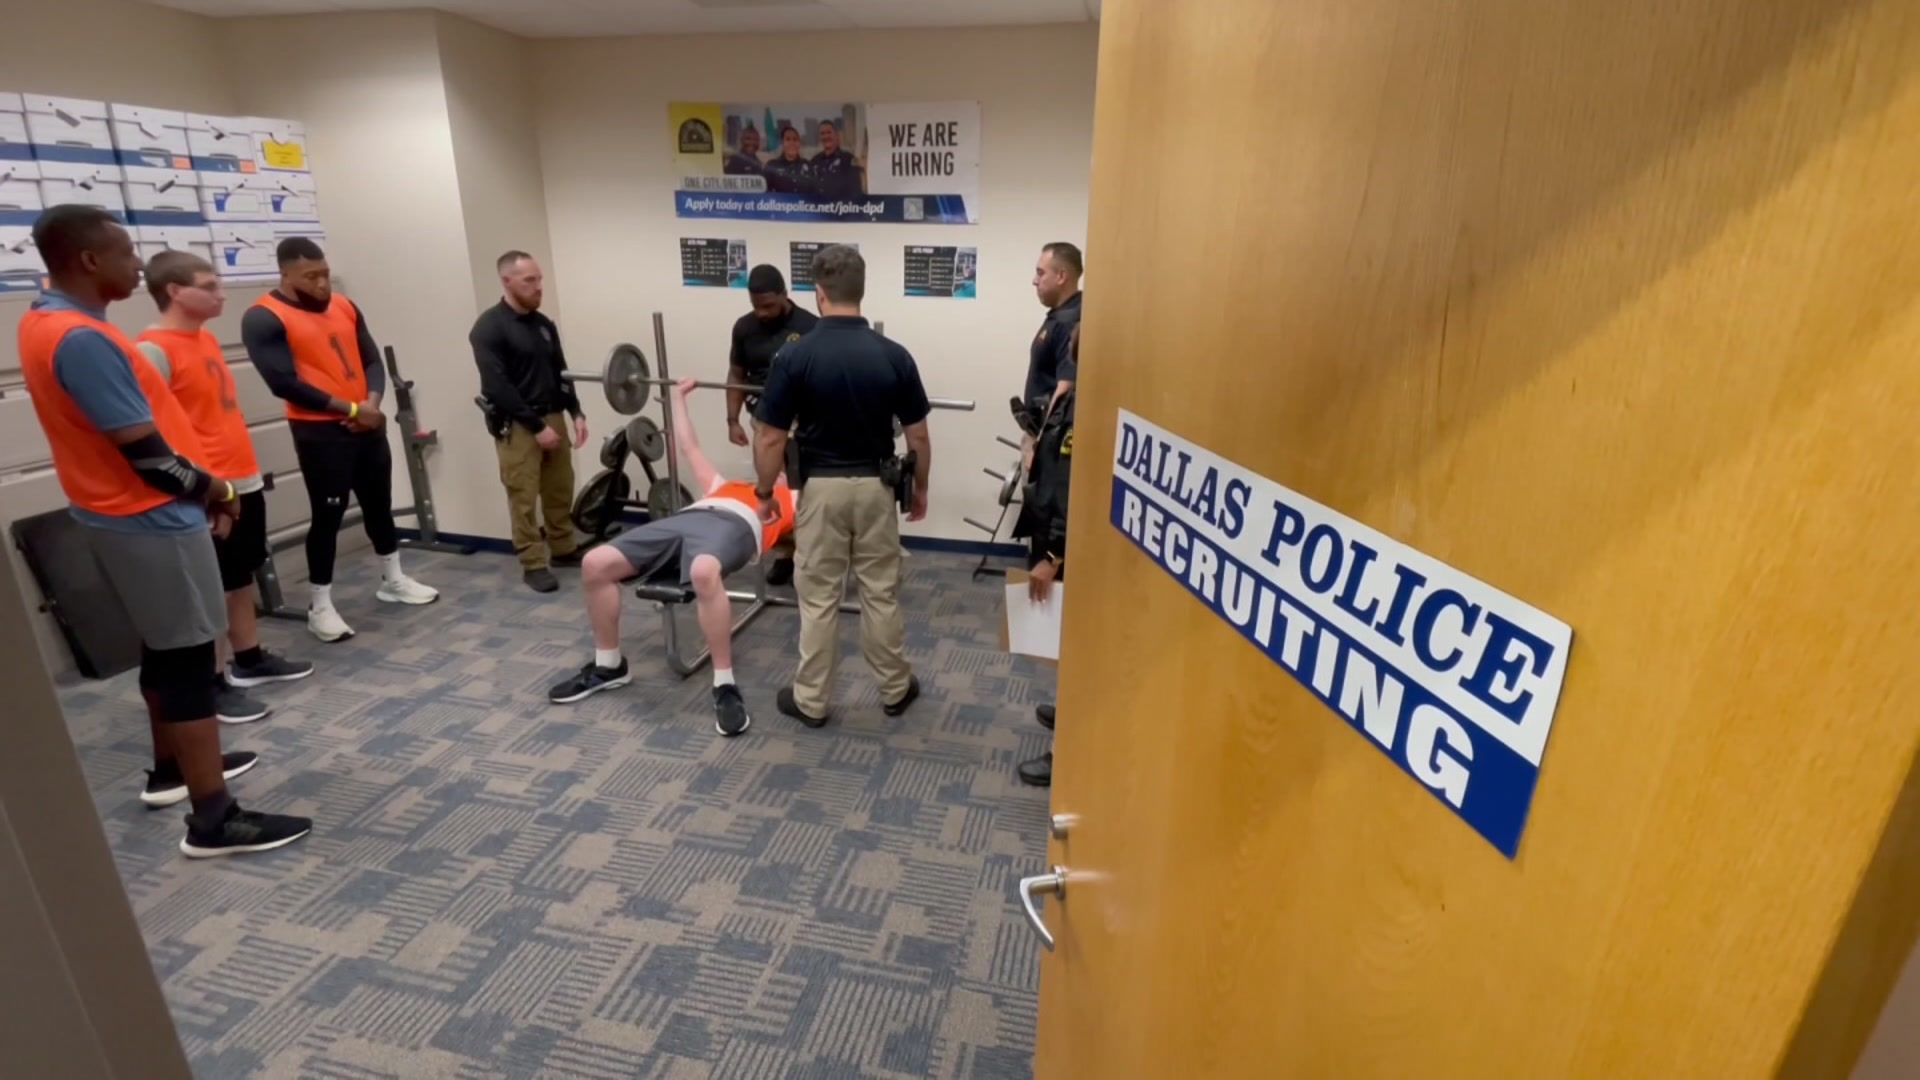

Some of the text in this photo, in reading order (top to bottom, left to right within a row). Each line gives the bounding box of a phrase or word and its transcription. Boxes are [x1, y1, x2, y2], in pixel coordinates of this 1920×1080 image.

[889, 121, 958, 149] WE ARE
[740, 177, 764, 190] TEAM
[891, 152, 955, 177] HIRING
[685, 197, 884, 216] Apply today at dallaspolice.net/join-dpd
[329, 332, 356, 380] 1
[206, 359, 236, 410] 2
[1117, 422, 1555, 726] DALLAS POLICE
[1122, 489, 1474, 809] RECRUITING
